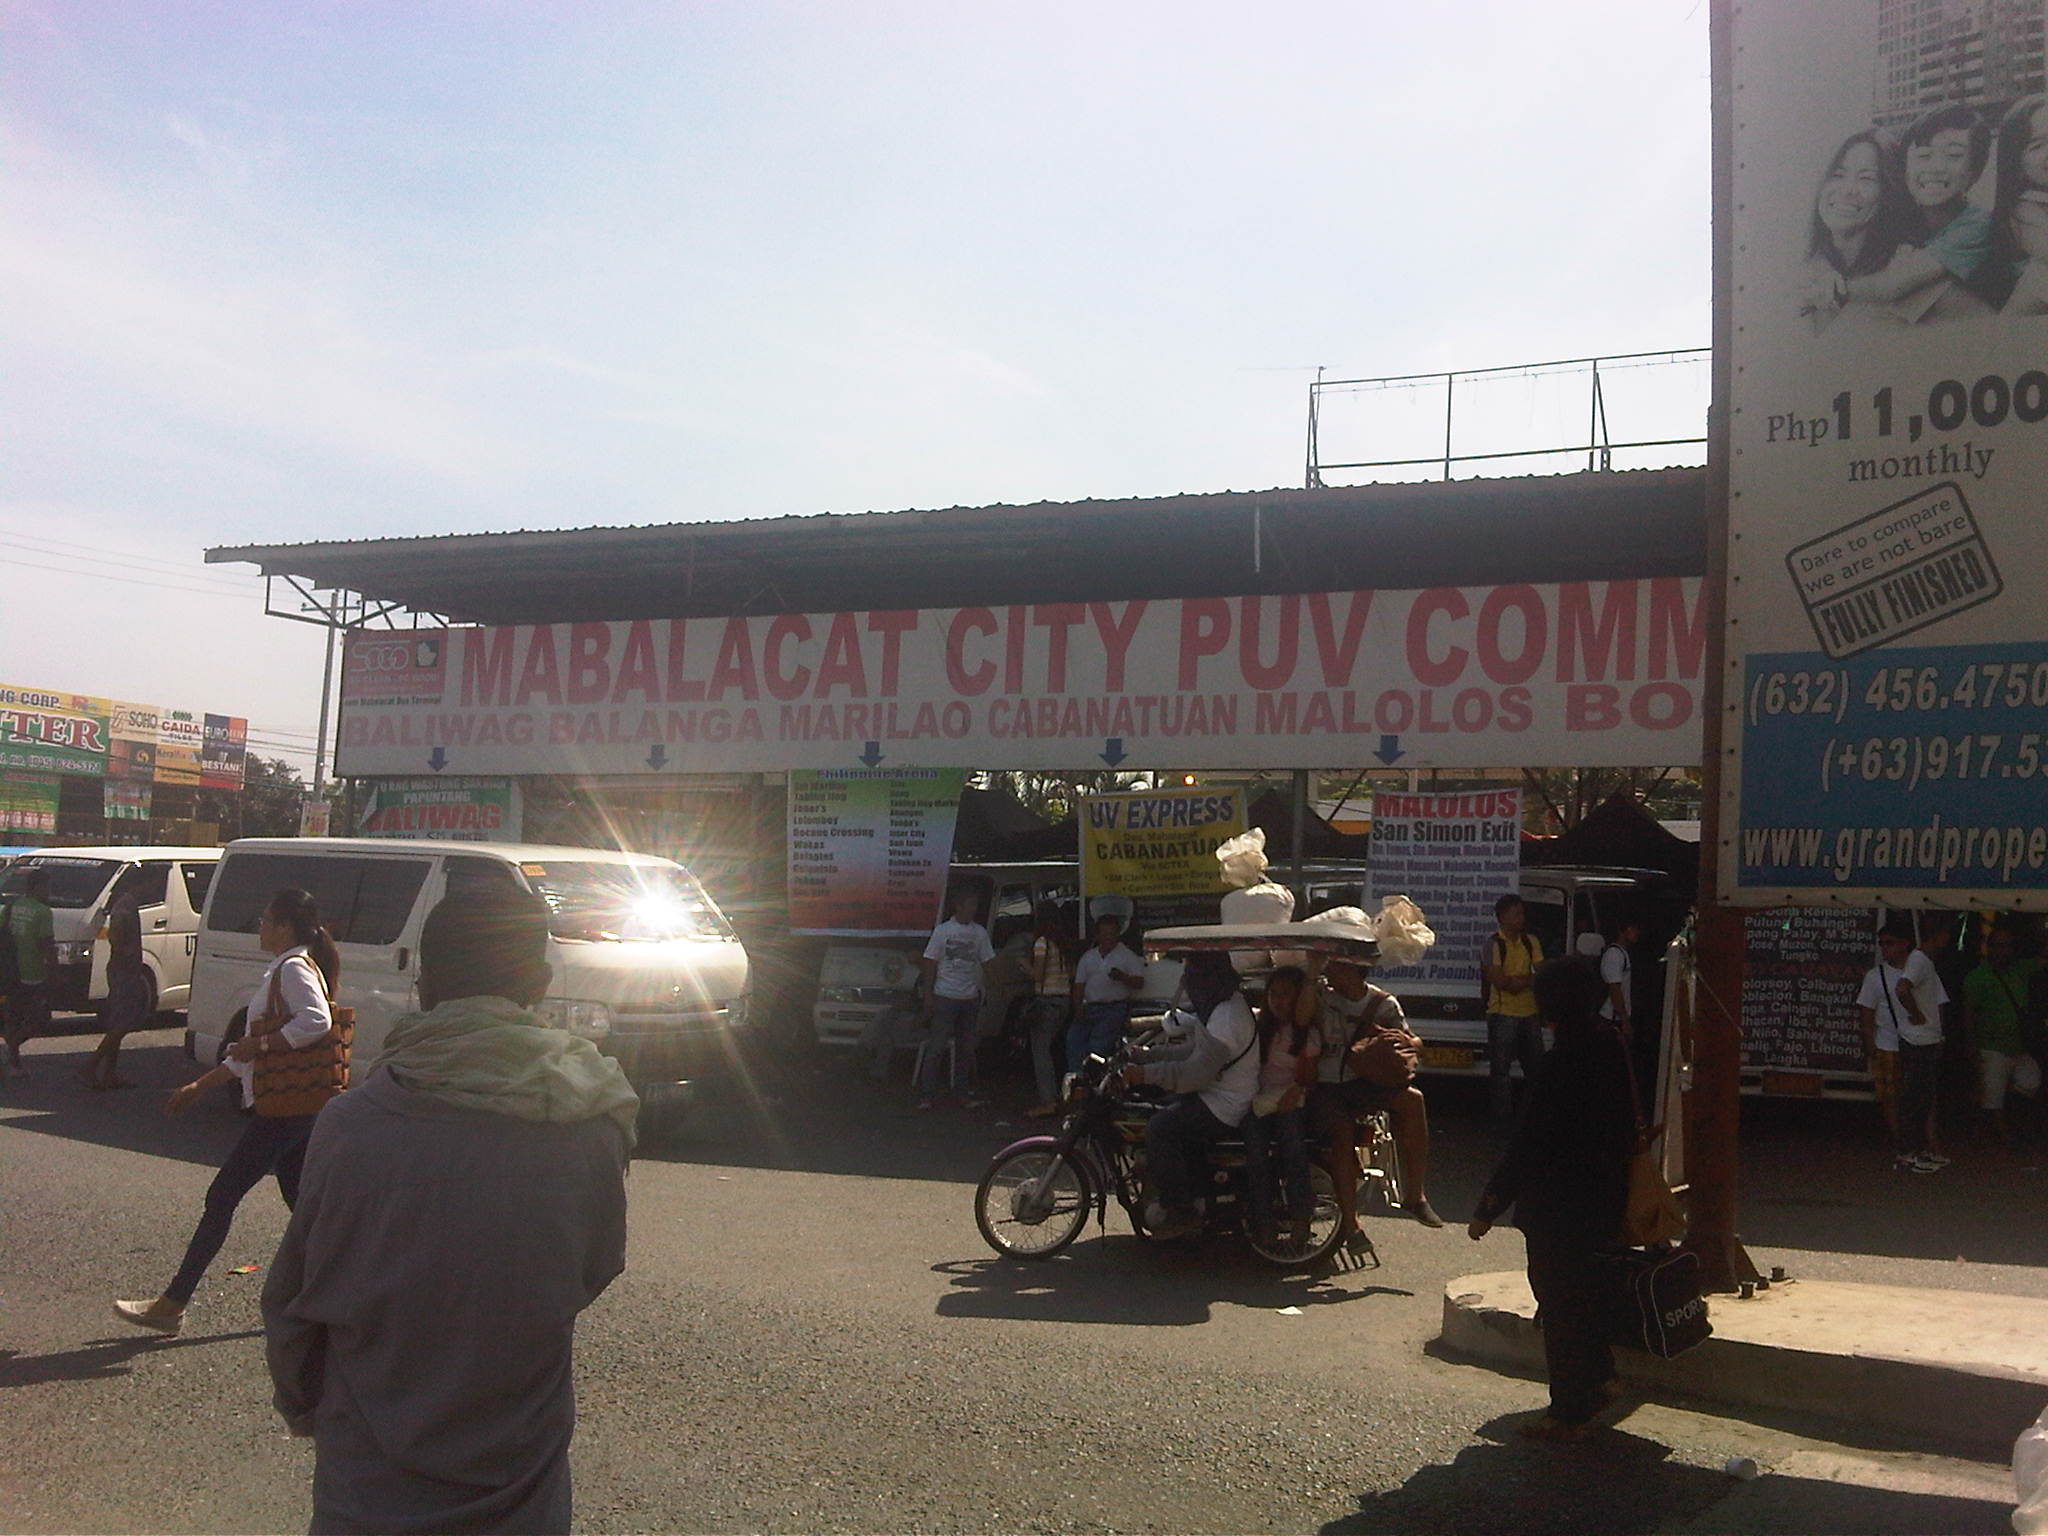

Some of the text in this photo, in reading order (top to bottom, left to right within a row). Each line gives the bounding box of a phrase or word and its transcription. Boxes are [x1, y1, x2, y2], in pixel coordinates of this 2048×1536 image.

[1848, 441, 1996, 481] monthly
[1800, 498, 1951, 573] Dare to compare
[1802, 514, 1967, 594] we are not bare
[1820, 547, 1989, 649] FULLY FINISHED
[458, 608, 919, 708] MABALACAT
[944, 601, 1148, 697] CITY
[1177, 588, 1376, 691] PUV
[343, 682, 1694, 748] BALIWAG BALANGA MARILAO CABANATUAN MALOLOS BO
[1750, 662, 2048, 726] (632) 456.4750
[160, 720, 202, 736] CAIDA
[1089, 795, 1234, 829] UV EXPRESS
[1372, 819, 1516, 843] San Simon Exit
[1096, 837, 1228, 861] CABANATUA
[1743, 813, 2048, 883] www.grandprope
